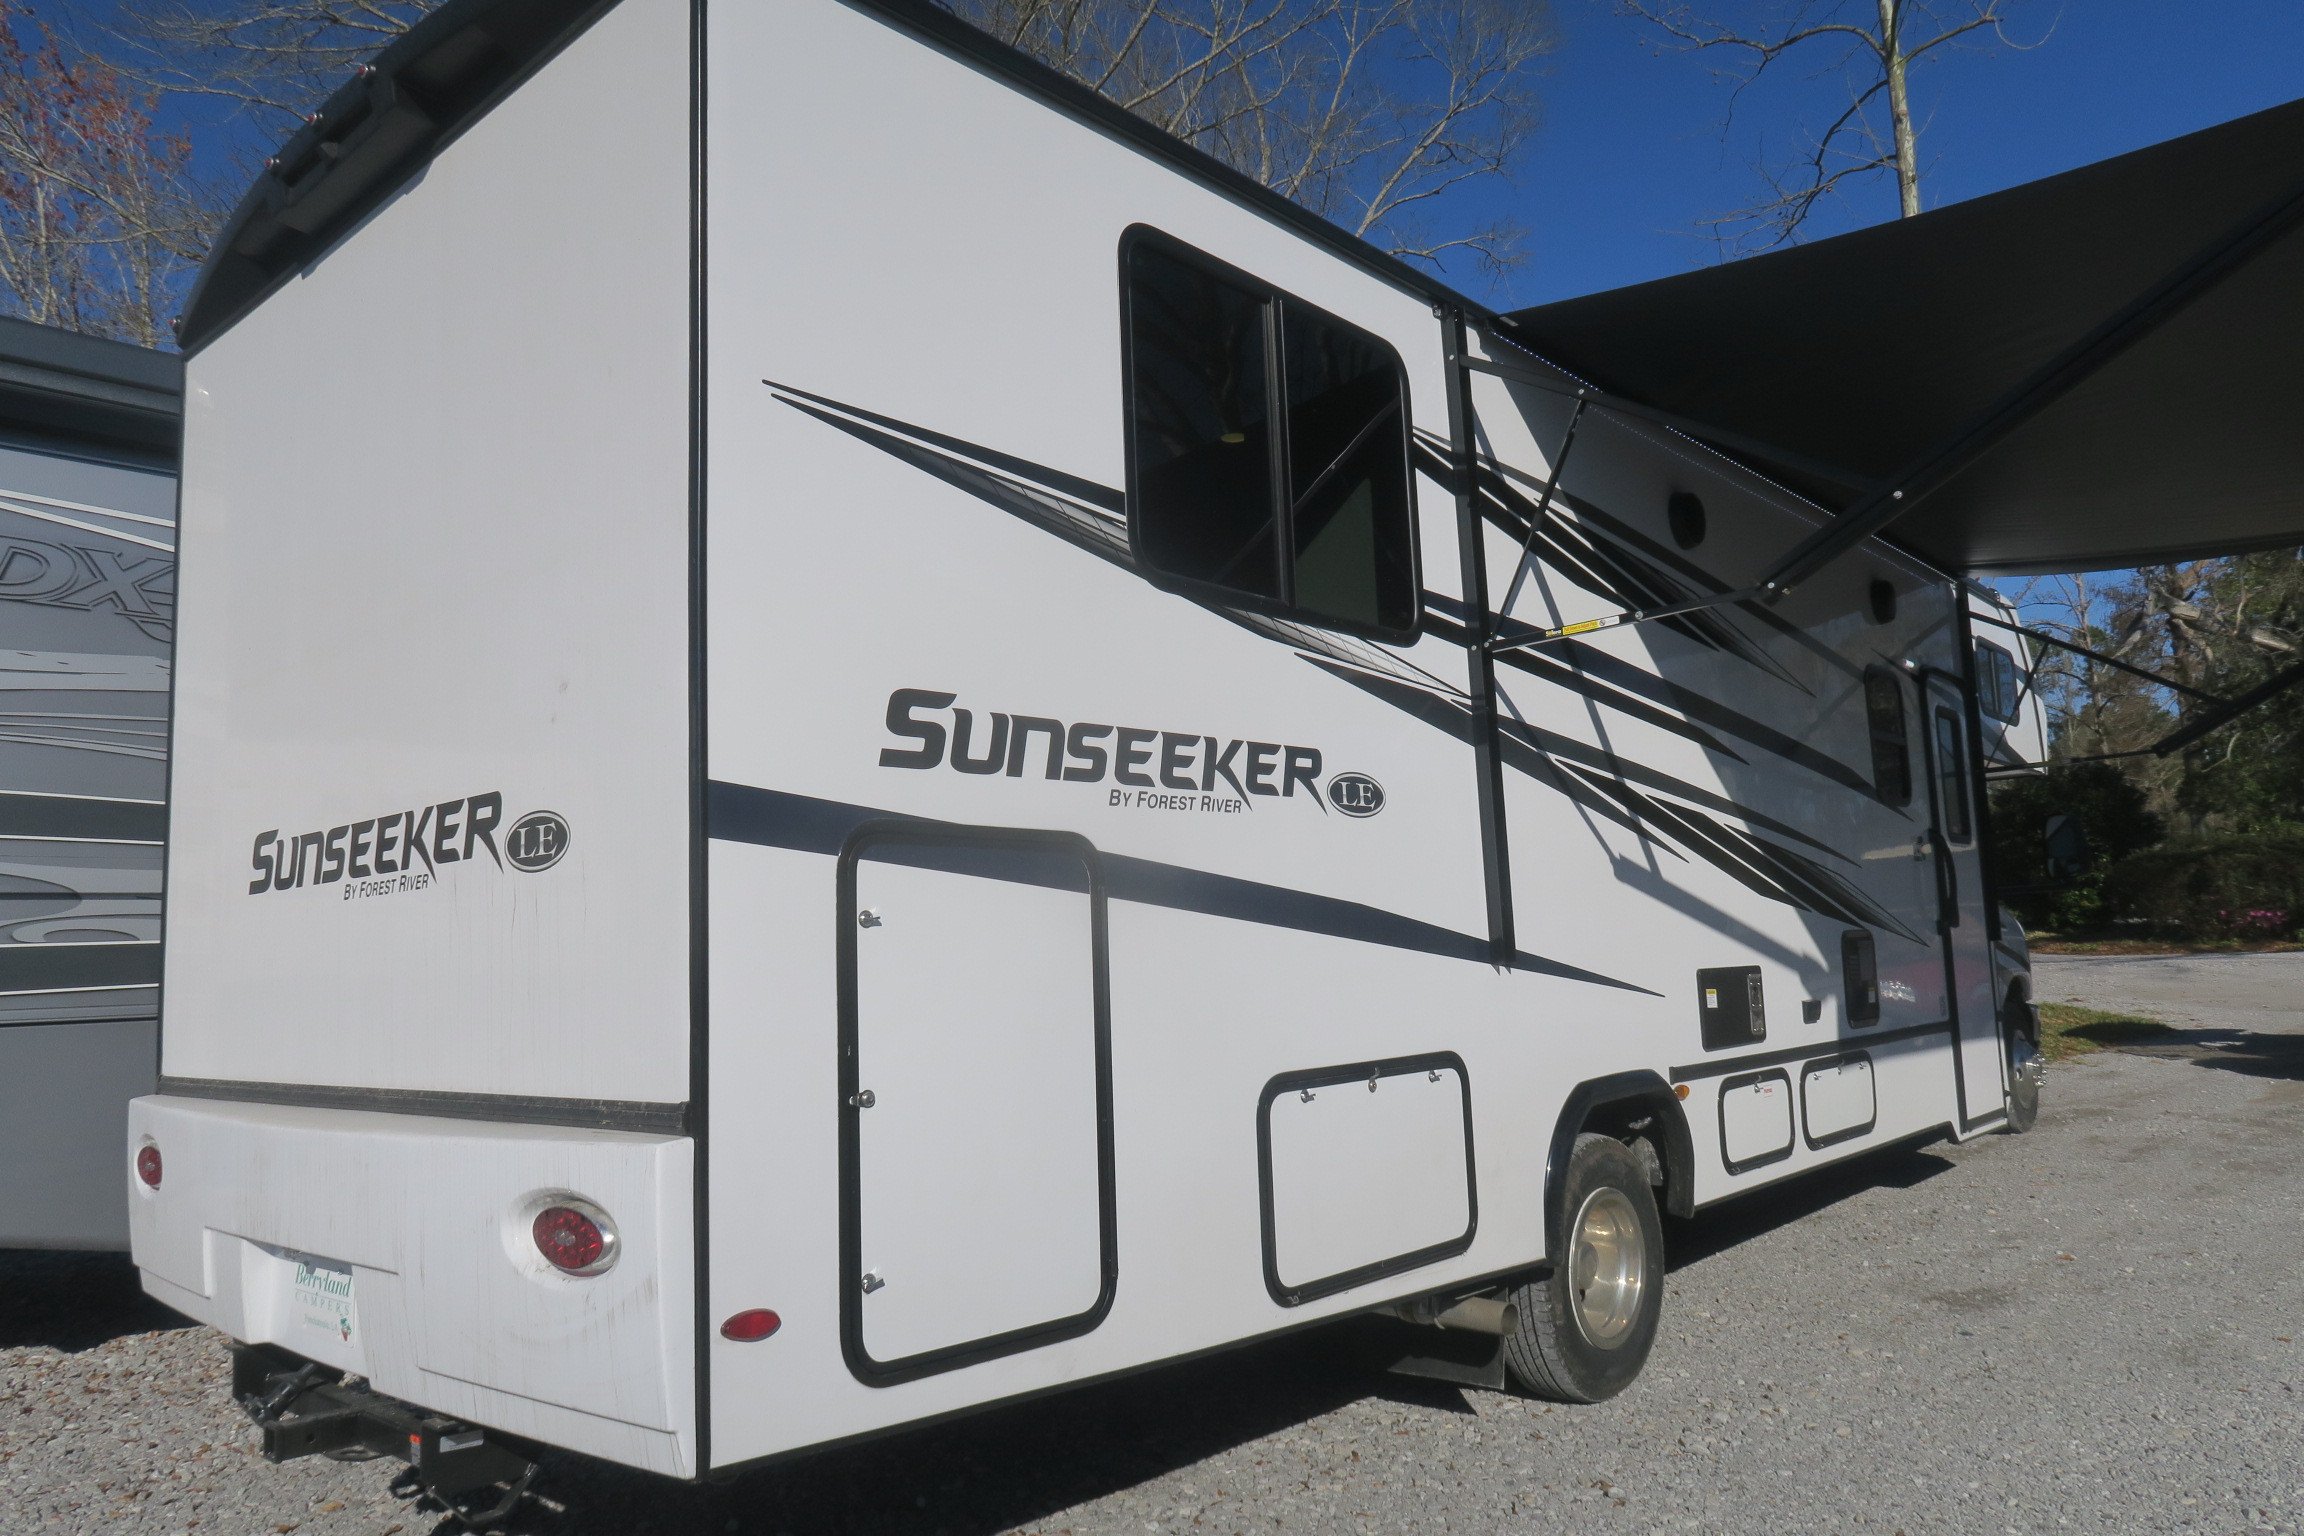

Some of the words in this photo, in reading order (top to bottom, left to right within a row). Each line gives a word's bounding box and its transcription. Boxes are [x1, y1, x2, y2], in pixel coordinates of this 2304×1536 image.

[879, 687, 1328, 816] SUNSEEKER
[1338, 779, 1376, 810] LE
[1109, 788, 1131, 808] BY
[1136, 790, 1197, 812] FOREST
[1200, 796, 1243, 815] RIVER
[249, 790, 504, 895] SUNSEEKER
[516, 820, 559, 860] LE
[343, 883, 357, 901] BY
[359, 879, 396, 899] FOREST
[399, 873, 429, 892] RIVER
[295, 1264, 352, 1298] Berryland
[295, 1291, 350, 1316] CAMPERS
